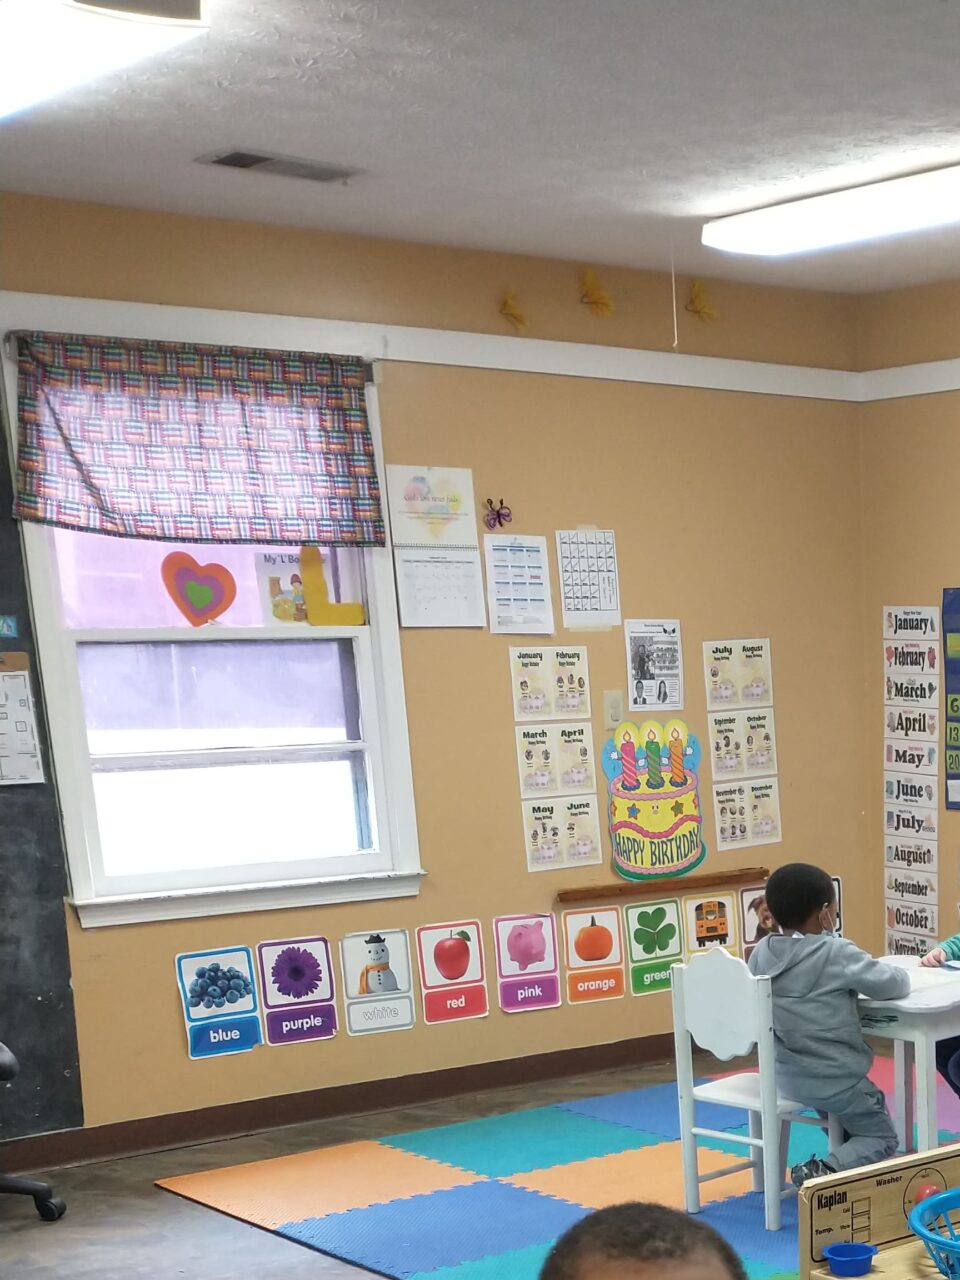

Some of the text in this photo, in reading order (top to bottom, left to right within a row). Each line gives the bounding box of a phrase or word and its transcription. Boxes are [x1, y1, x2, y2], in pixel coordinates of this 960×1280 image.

[264, 555, 277, 565] My
[893, 614, 929, 635] January
[517, 652, 543, 661] January
[555, 651, 581, 661] February
[712, 646, 733, 656] July
[742, 645, 763, 655] August
[894, 646, 926, 671] February
[893, 681, 927, 699] March
[950, 697, 960, 713] 6
[746, 715, 767, 724] October
[895, 712, 927, 737] April
[522, 730, 548, 740] March
[561, 728, 584, 739] April
[949, 726, 959, 742] 13
[894, 749, 925, 768] May
[949, 754, 960, 770] 20
[715, 788, 737, 799] November
[751, 784, 773, 793] December
[895, 779, 924, 800] June
[531, 806, 554, 816] May
[566, 801, 591, 811] June
[894, 814, 925, 833] July
[614, 826, 702, 867] HAPPY BIRTHDAY
[893, 845, 927, 867] August
[893, 876, 928, 898] September
[895, 908, 929, 931] October
[894, 938, 921, 956] Novemb
[577, 976, 616, 993] orange
[517, 985, 542, 1001] pink
[446, 995, 466, 1009] red
[362, 1005, 399, 1022] white
[282, 1014, 323, 1034] purple
[209, 1026, 241, 1043] blue
[875, 1175, 903, 1187] Washer
[817, 1190, 847, 1211] Kaplan
[815, 1225, 834, 1236] Temp.
